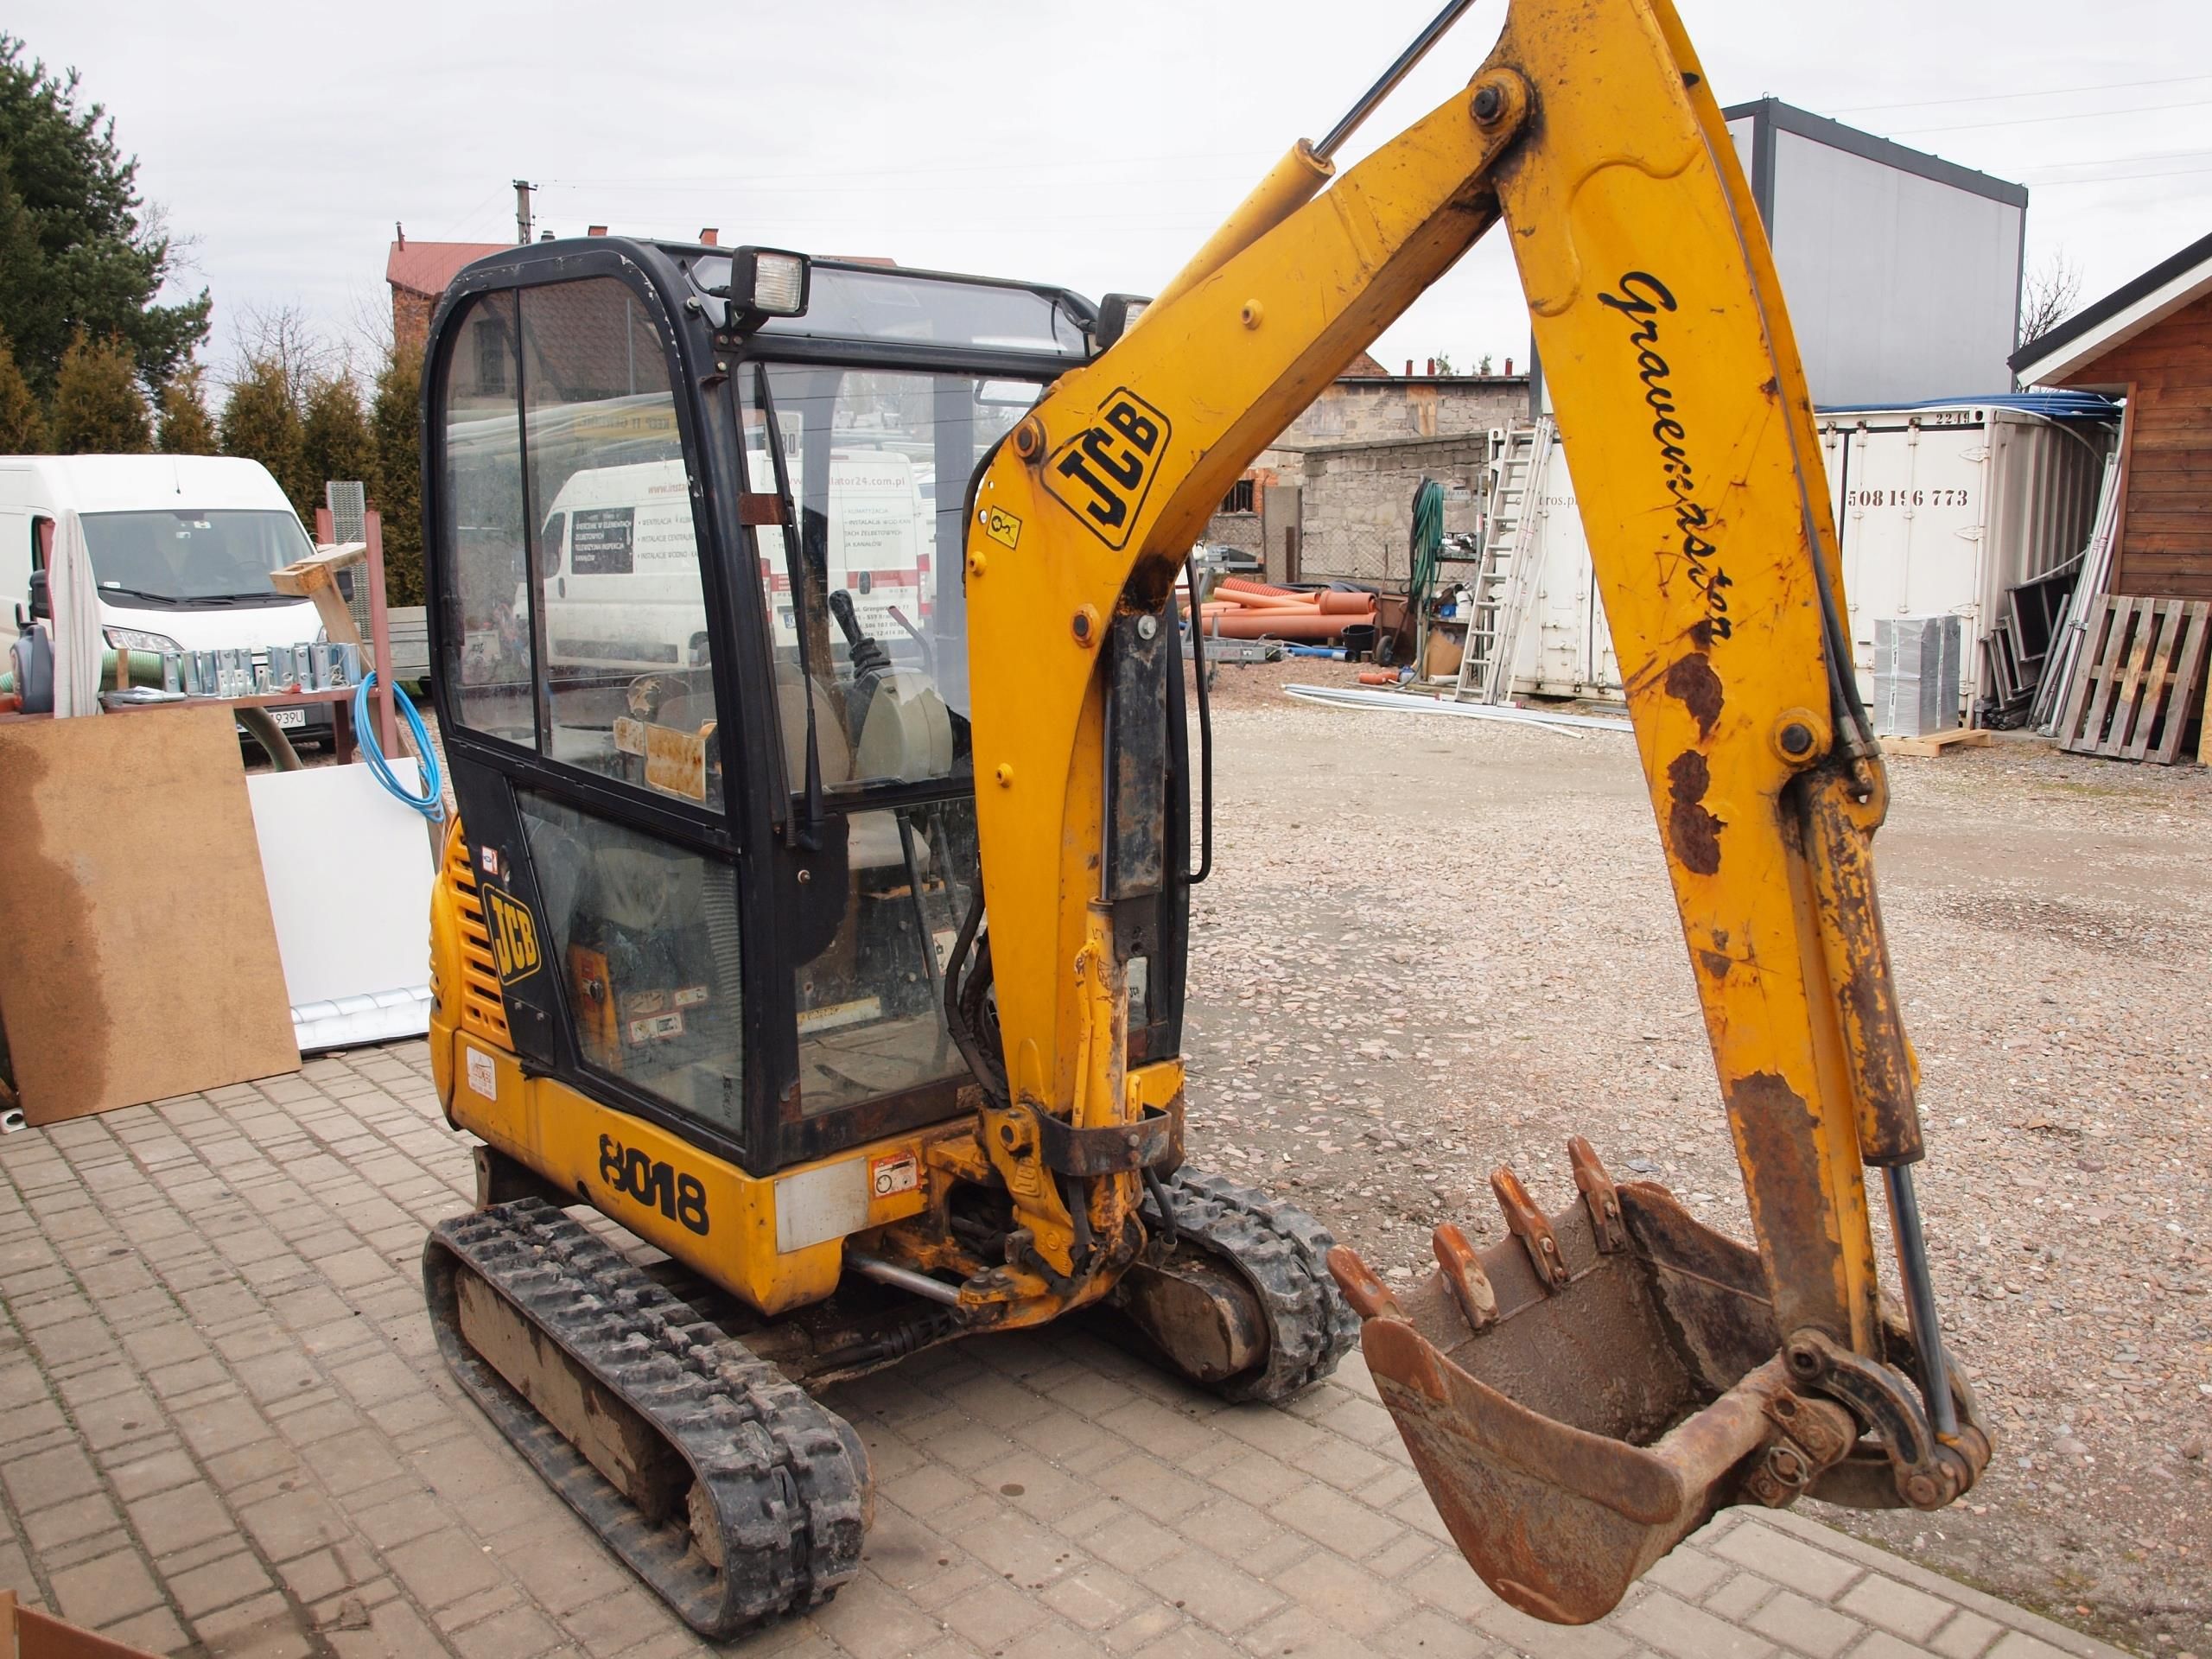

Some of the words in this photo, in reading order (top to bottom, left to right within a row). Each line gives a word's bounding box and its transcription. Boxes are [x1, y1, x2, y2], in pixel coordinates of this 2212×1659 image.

[1057, 401, 1159, 528] JCB
[1848, 490, 1884, 506] 508
[1890, 490, 1923, 506] 196
[1932, 490, 1968, 506] 773
[269, 711, 303, 725] 939U
[490, 893, 537, 976] JCB
[599, 1133, 710, 1236] 8018
